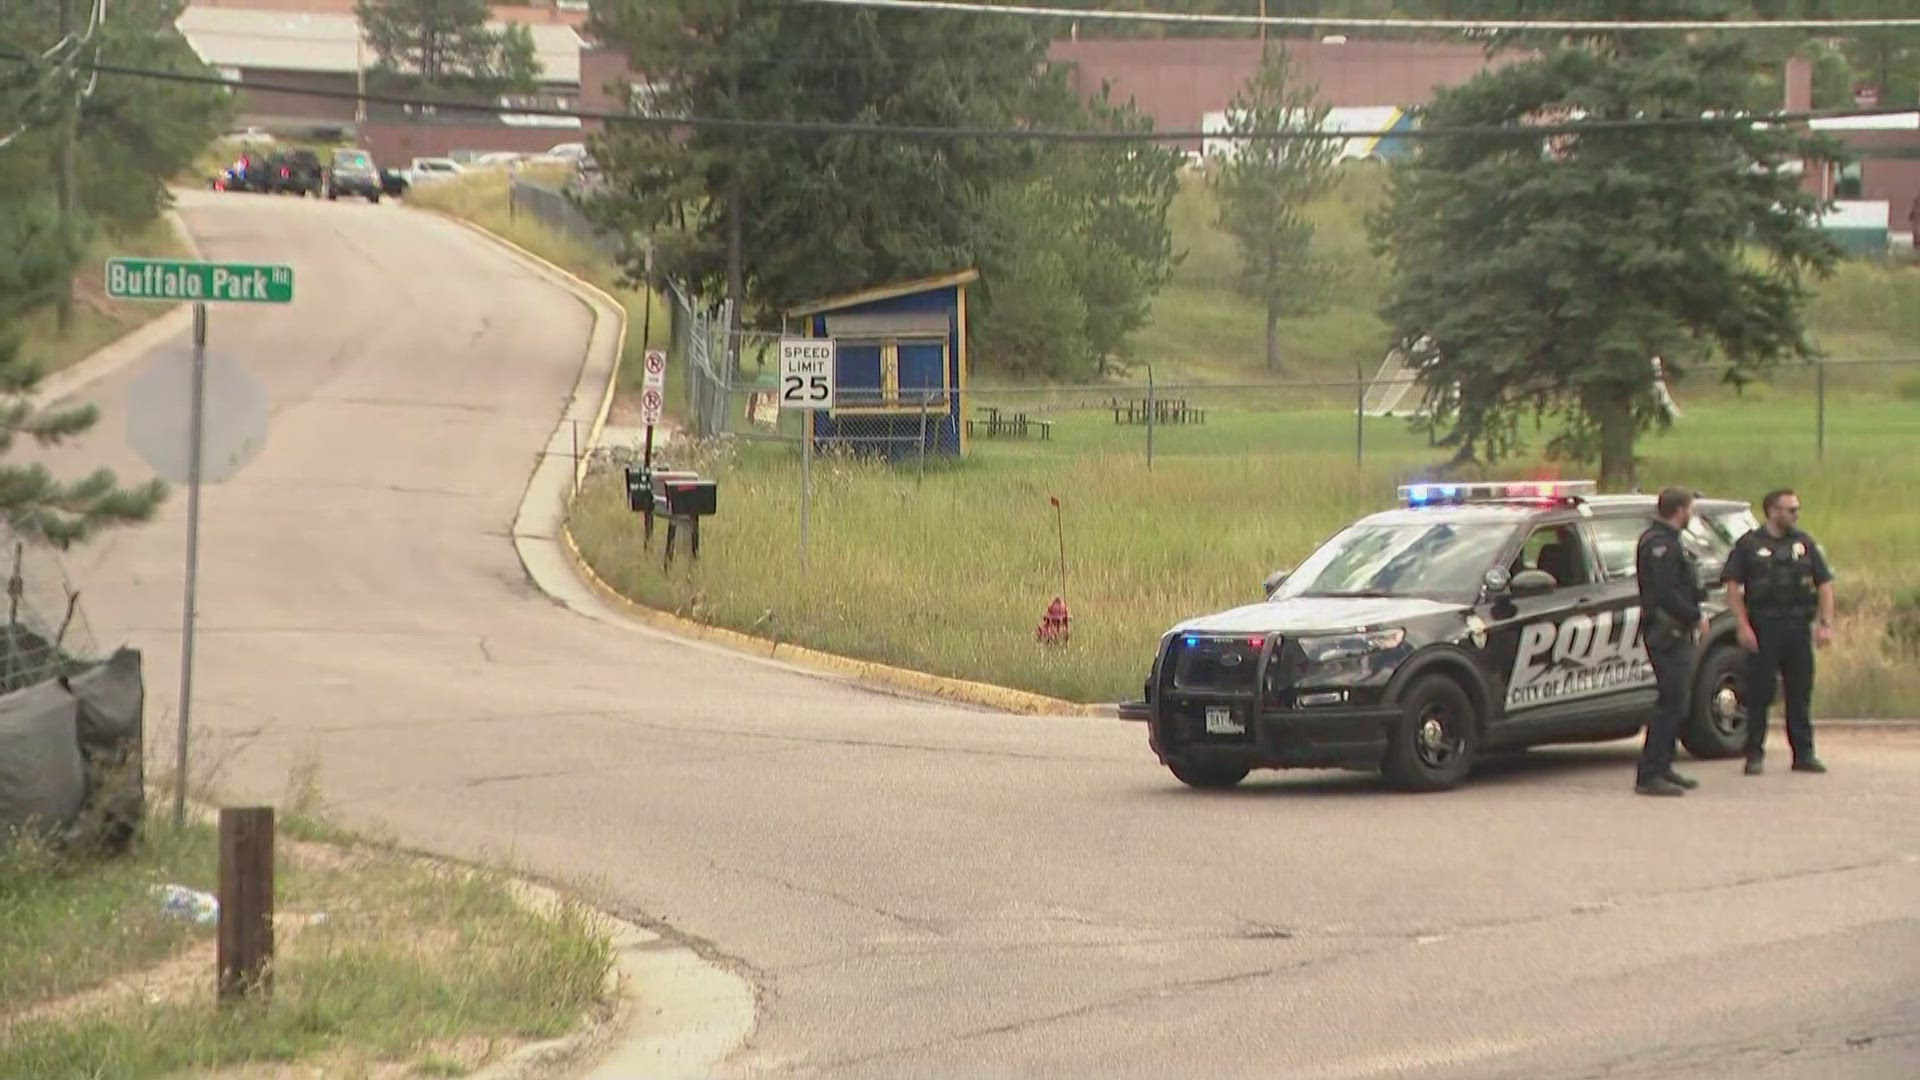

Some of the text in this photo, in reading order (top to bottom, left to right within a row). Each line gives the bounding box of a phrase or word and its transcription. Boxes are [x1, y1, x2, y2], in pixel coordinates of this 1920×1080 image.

[111, 264, 203, 297] Buffalo
[212, 268, 268, 299] Park
[785, 347, 830, 359] SPEED
[789, 361, 825, 372] LIMIT
[784, 376, 829, 401] 25
[1512, 686, 1541, 704] CITY
[1544, 679, 1560, 698] OF
